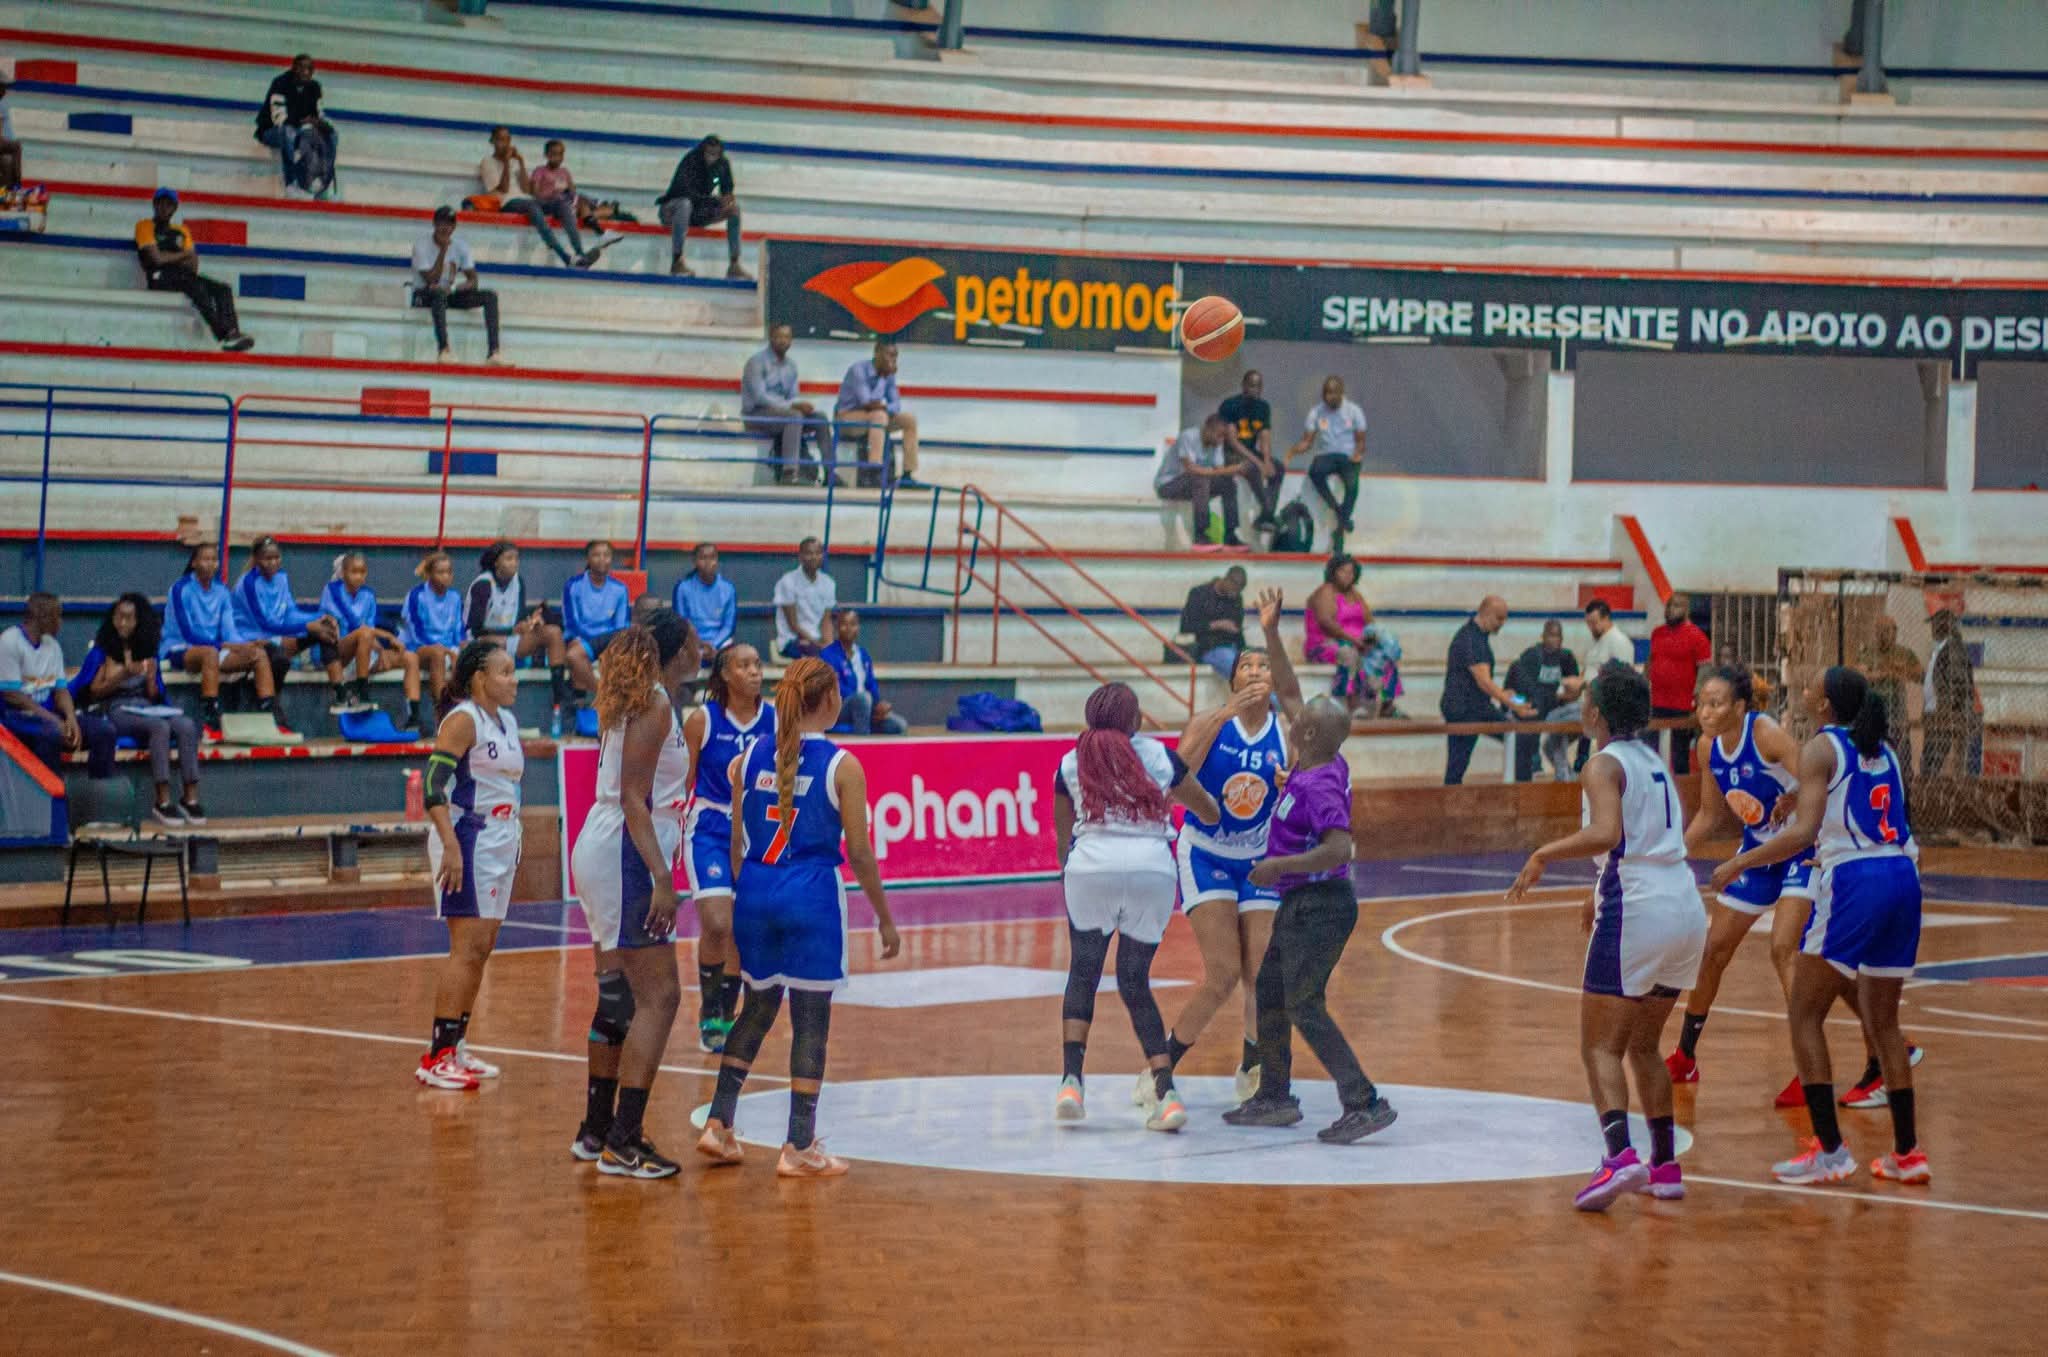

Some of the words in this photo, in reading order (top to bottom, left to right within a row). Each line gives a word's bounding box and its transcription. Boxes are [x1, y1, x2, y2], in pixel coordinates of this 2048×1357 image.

[1322, 296, 1473, 336] SEMPRE
[1483, 302, 1679, 342] PRESENTE
[1690, 308, 1749, 345] NO
[1760, 310, 1888, 347] APOIO
[1896, 315, 1952, 348] AO
[1963, 316, 2048, 352] DES
[487, 741, 498, 760] 8
[1238, 748, 1263, 771] 15
[1729, 766, 1740, 786] 6
[762, 805, 799, 865] 7
[866, 771, 1040, 861] phant
